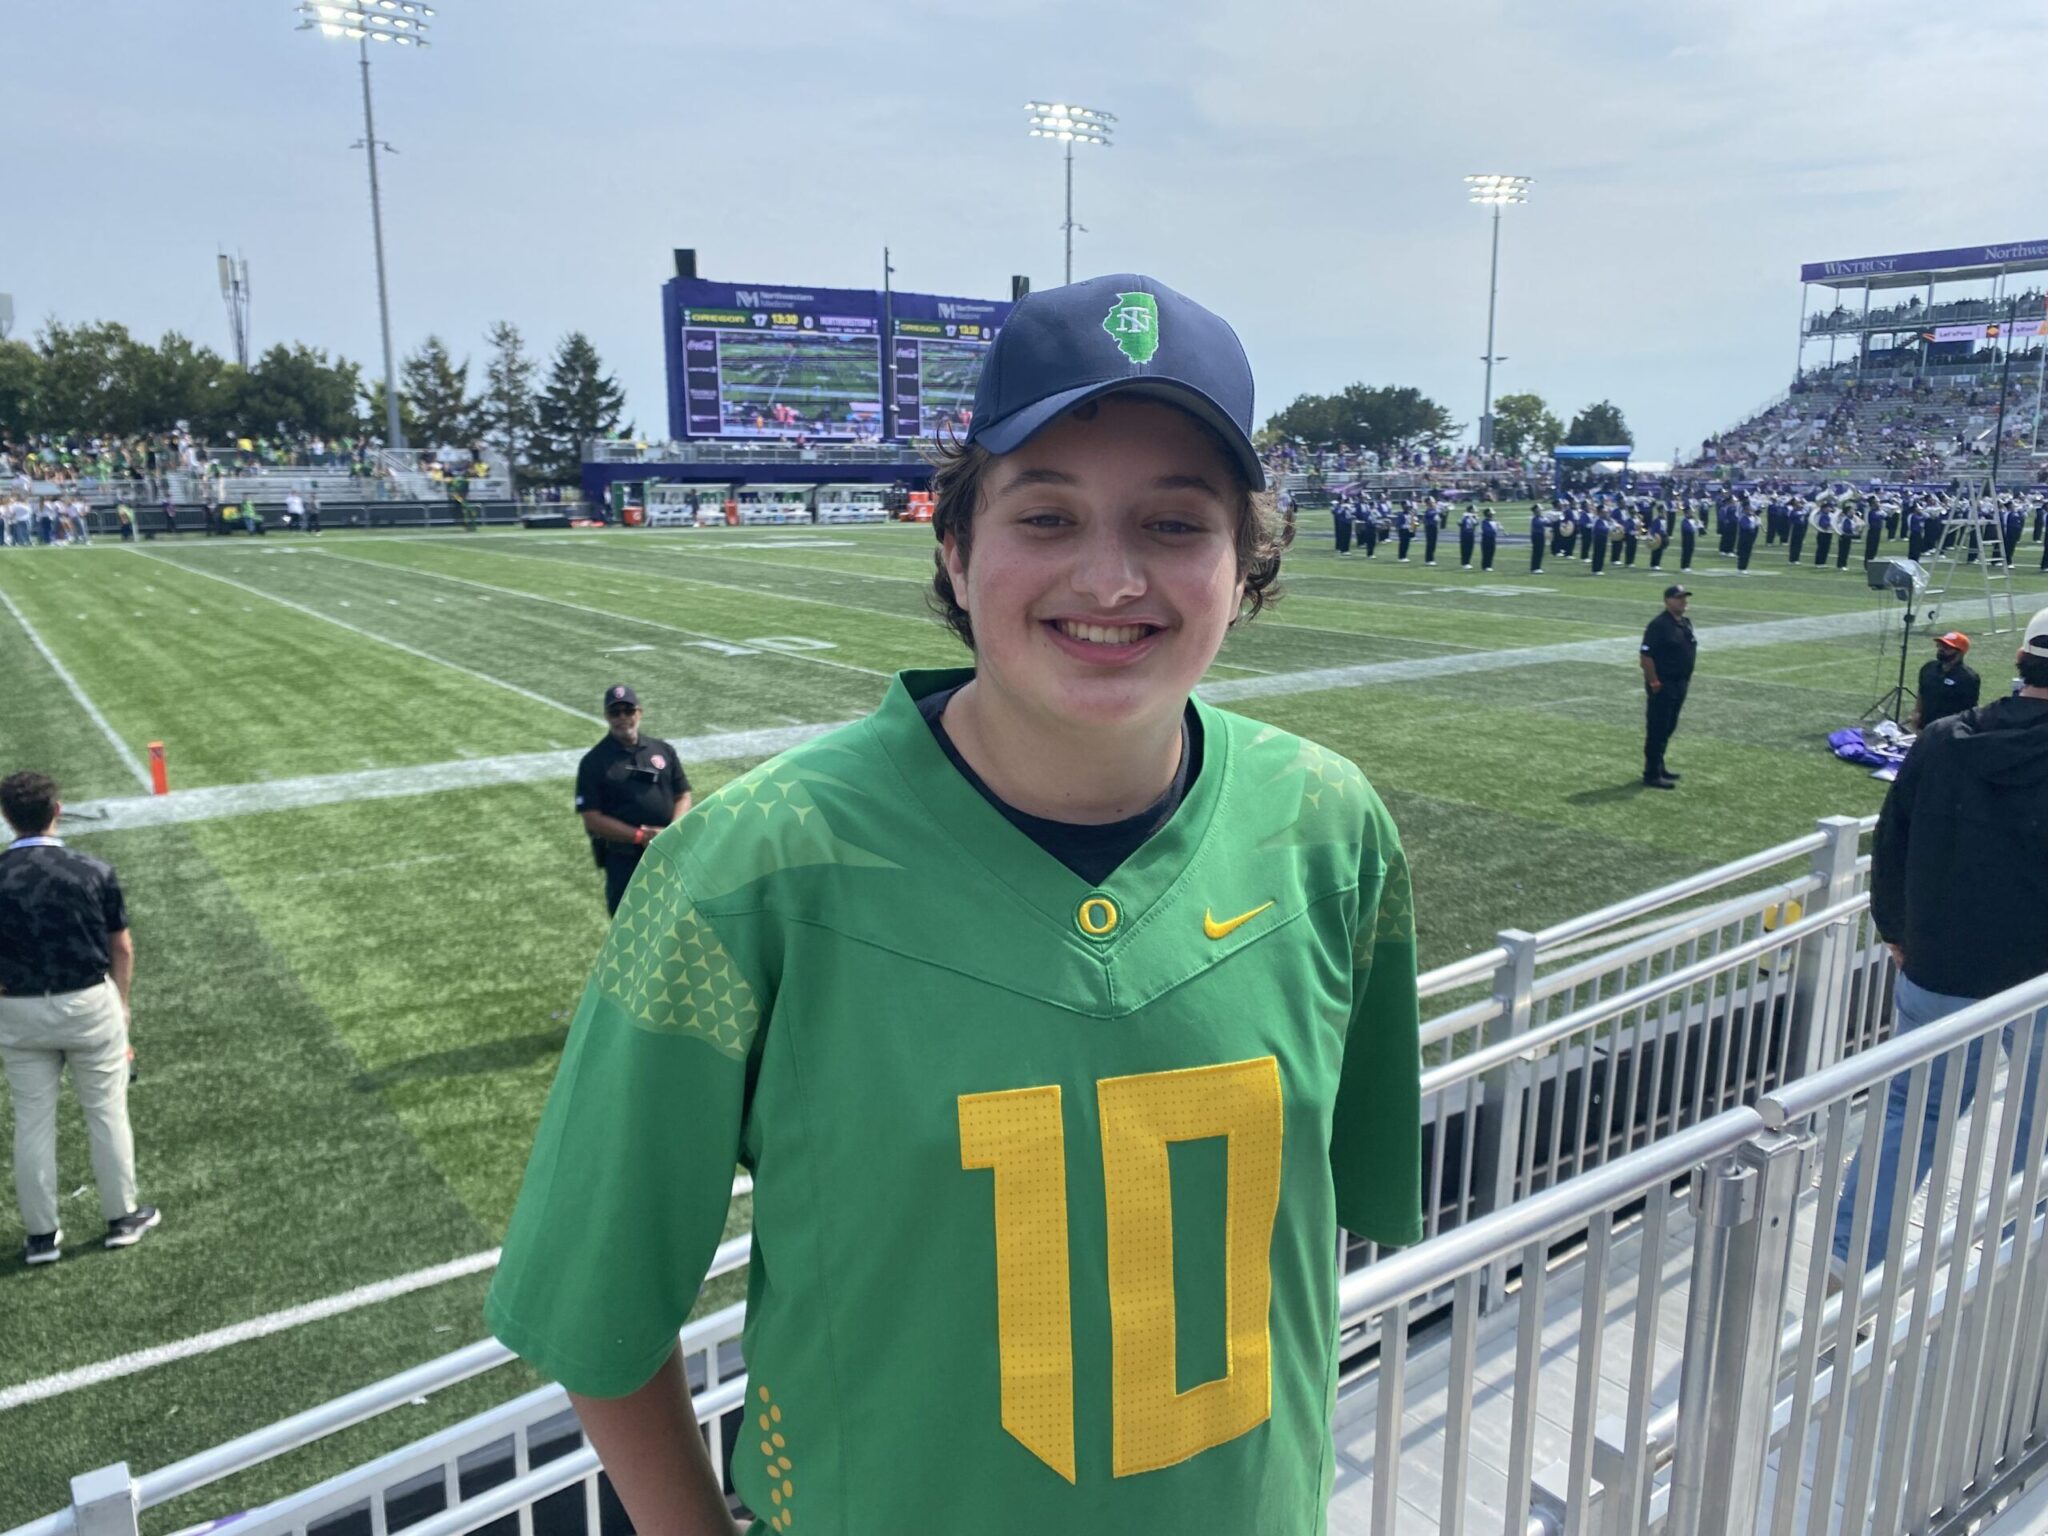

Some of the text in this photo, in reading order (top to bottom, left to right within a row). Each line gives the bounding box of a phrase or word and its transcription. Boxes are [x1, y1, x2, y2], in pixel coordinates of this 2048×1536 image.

[1824, 258, 1897, 275] WINTRUST
[691, 313, 746, 324] OREGON
[752, 313, 769, 327] 17
[803, 315, 814, 329] 0
[1078, 898, 1118, 935] O
[957, 1056, 1283, 1486] 10
